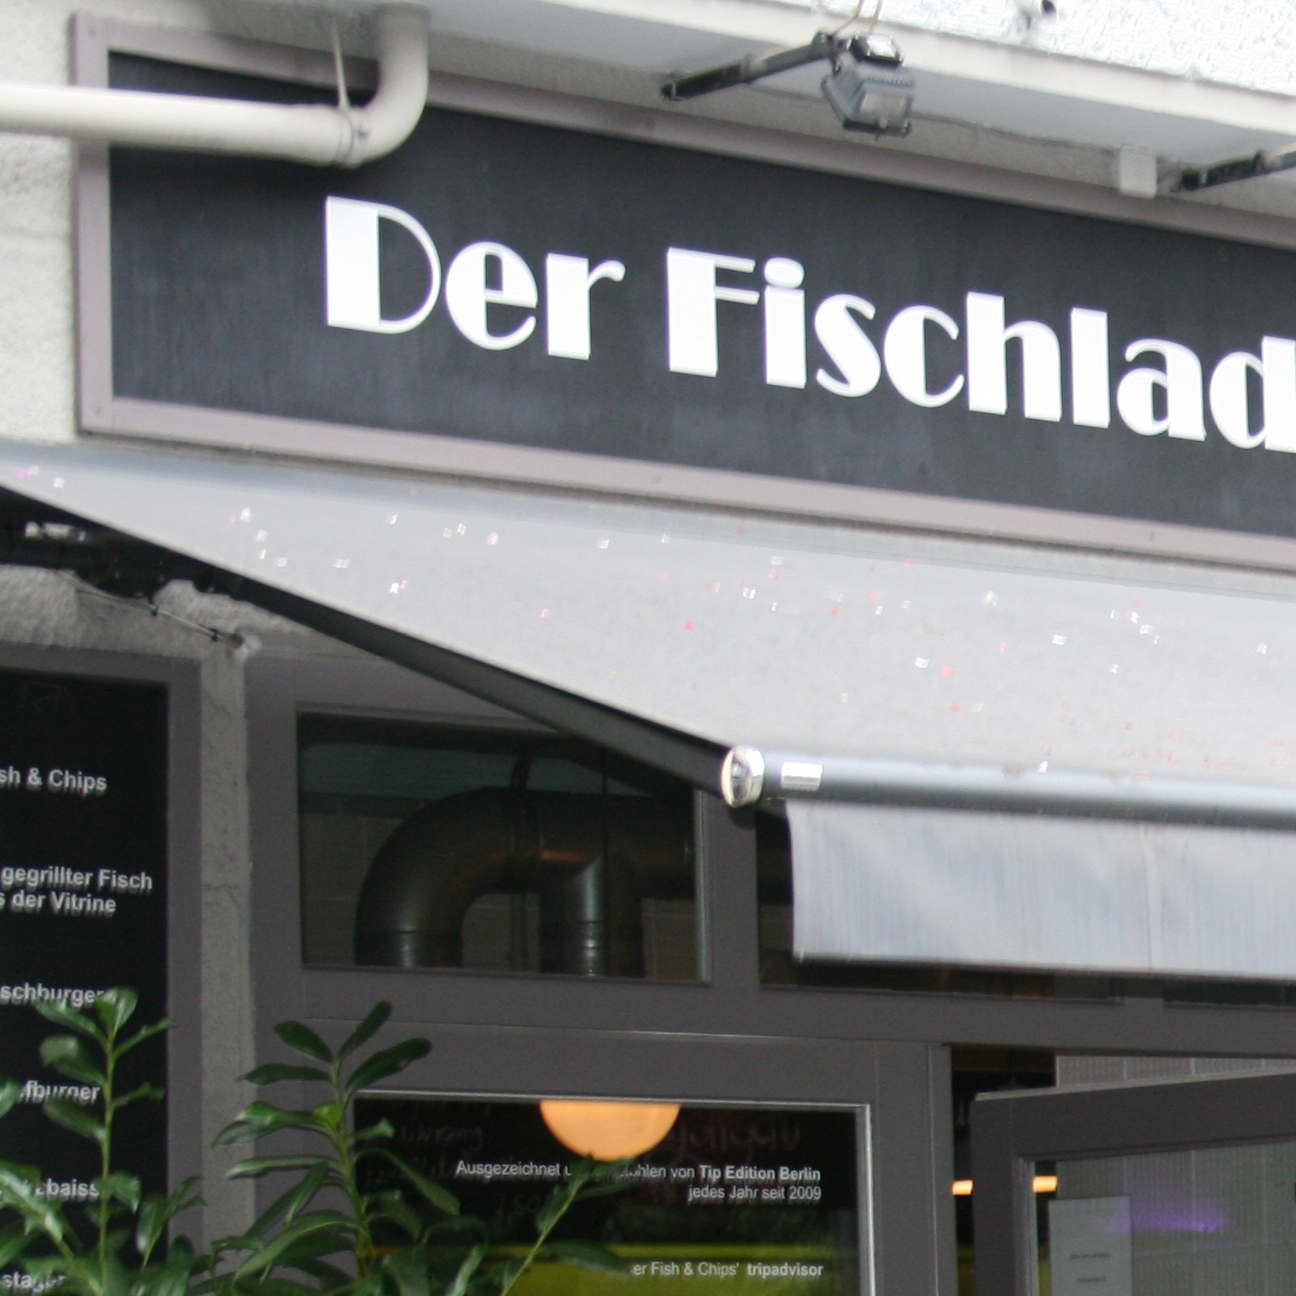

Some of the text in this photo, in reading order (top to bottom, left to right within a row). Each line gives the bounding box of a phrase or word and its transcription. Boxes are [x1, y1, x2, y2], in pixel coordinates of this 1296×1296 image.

[325, 195, 625, 358] Der
[28, 767, 43, 786] &
[49, 769, 108, 794] Chips
[2, 866, 153, 890] gegrillter Fisch
[11, 889, 46, 909] der
[50, 890, 117, 913] Vitrine
[456, 1160, 562, 1179] Ausgezeichnet
[671, 1167, 695, 1179] von
[700, 1165, 722, 1182] Tip
[725, 1165, 776, 1181] Edition
[779, 1166, 821, 1181] Berlin
[688, 1184, 822, 1202] jedes Jahr seit 2009
[652, 1262, 680, 1276] Fish
[683, 1263, 694, 1276] &
[747, 1262, 824, 1280] tripadvisor
